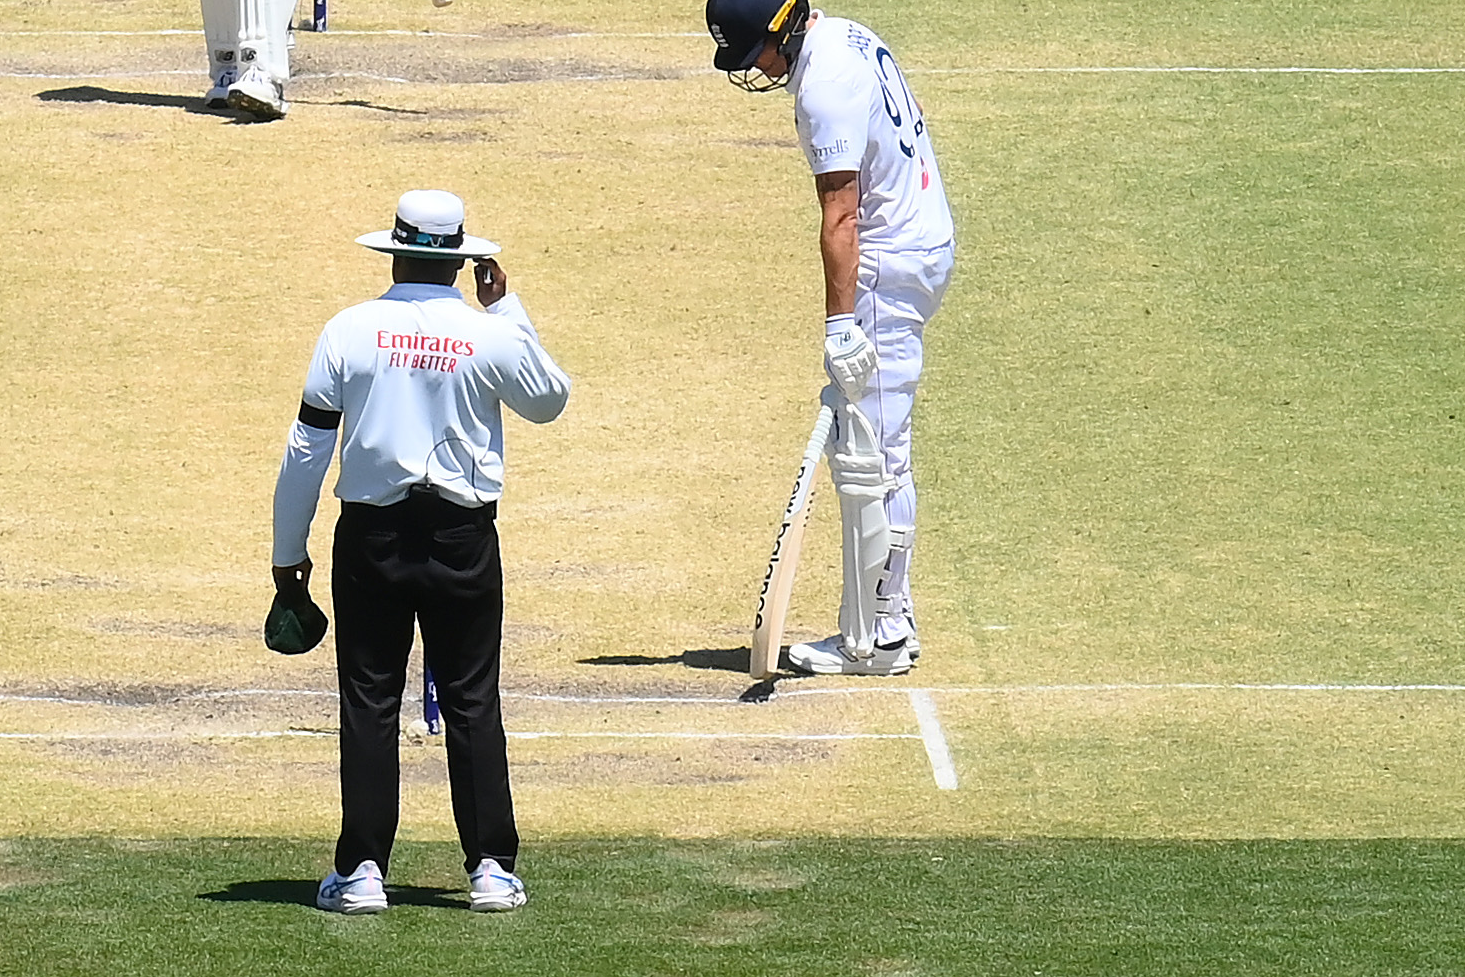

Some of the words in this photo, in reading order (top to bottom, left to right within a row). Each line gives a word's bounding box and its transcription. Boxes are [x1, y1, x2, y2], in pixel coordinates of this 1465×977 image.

[377, 330, 475, 357] Emirates
[389, 352, 410, 368] FLY
[411, 354, 457, 374] BETTER
